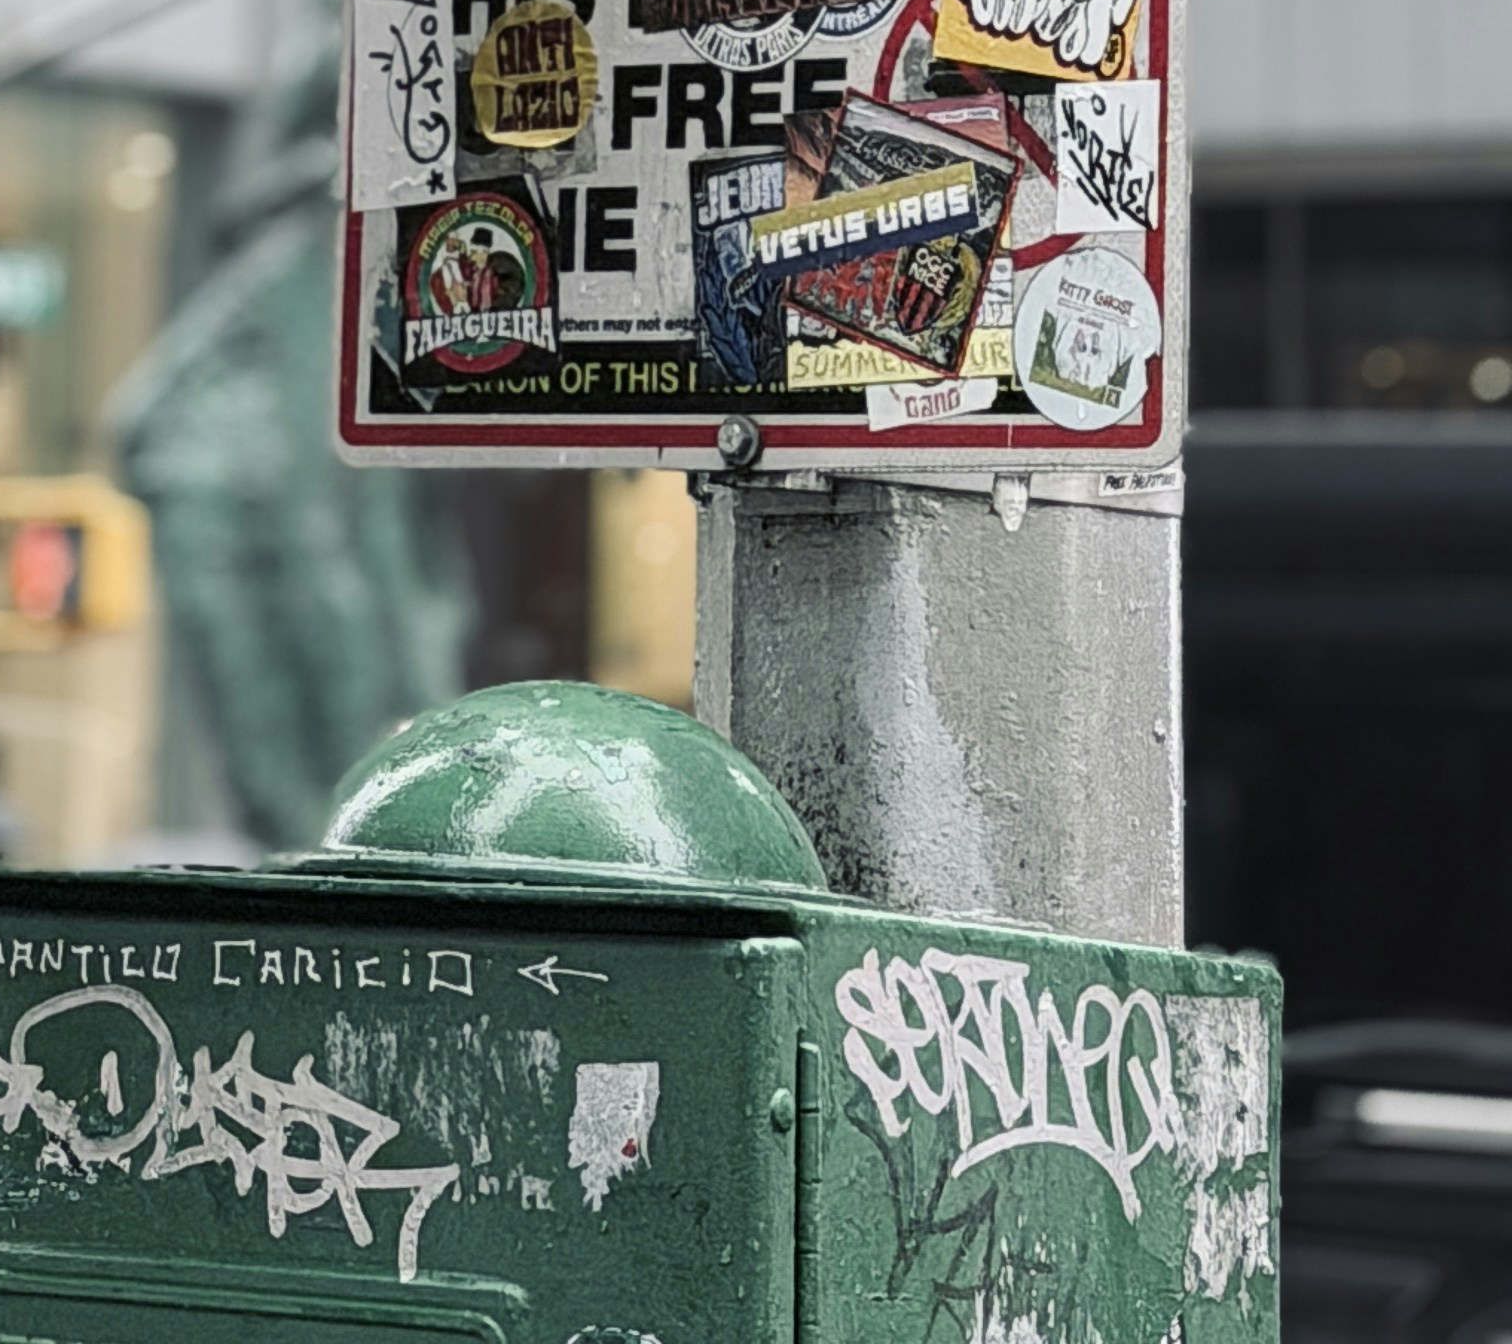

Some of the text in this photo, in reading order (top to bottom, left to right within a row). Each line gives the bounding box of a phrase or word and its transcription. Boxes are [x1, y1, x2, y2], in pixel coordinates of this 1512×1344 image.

[496, 16, 575, 76] ANTI
[756, 18, 804, 67] PARIS
[494, 77, 581, 133] LAZIO
[611, 57, 848, 150] FREE
[759, 211, 867, 264] VETUS
[404, 307, 557, 365] FALAGUEIRA
[602, 318, 633, 334] may
[636, 317, 661, 332] not
[560, 362, 601, 394] OF
[609, 362, 680, 394] THIS
